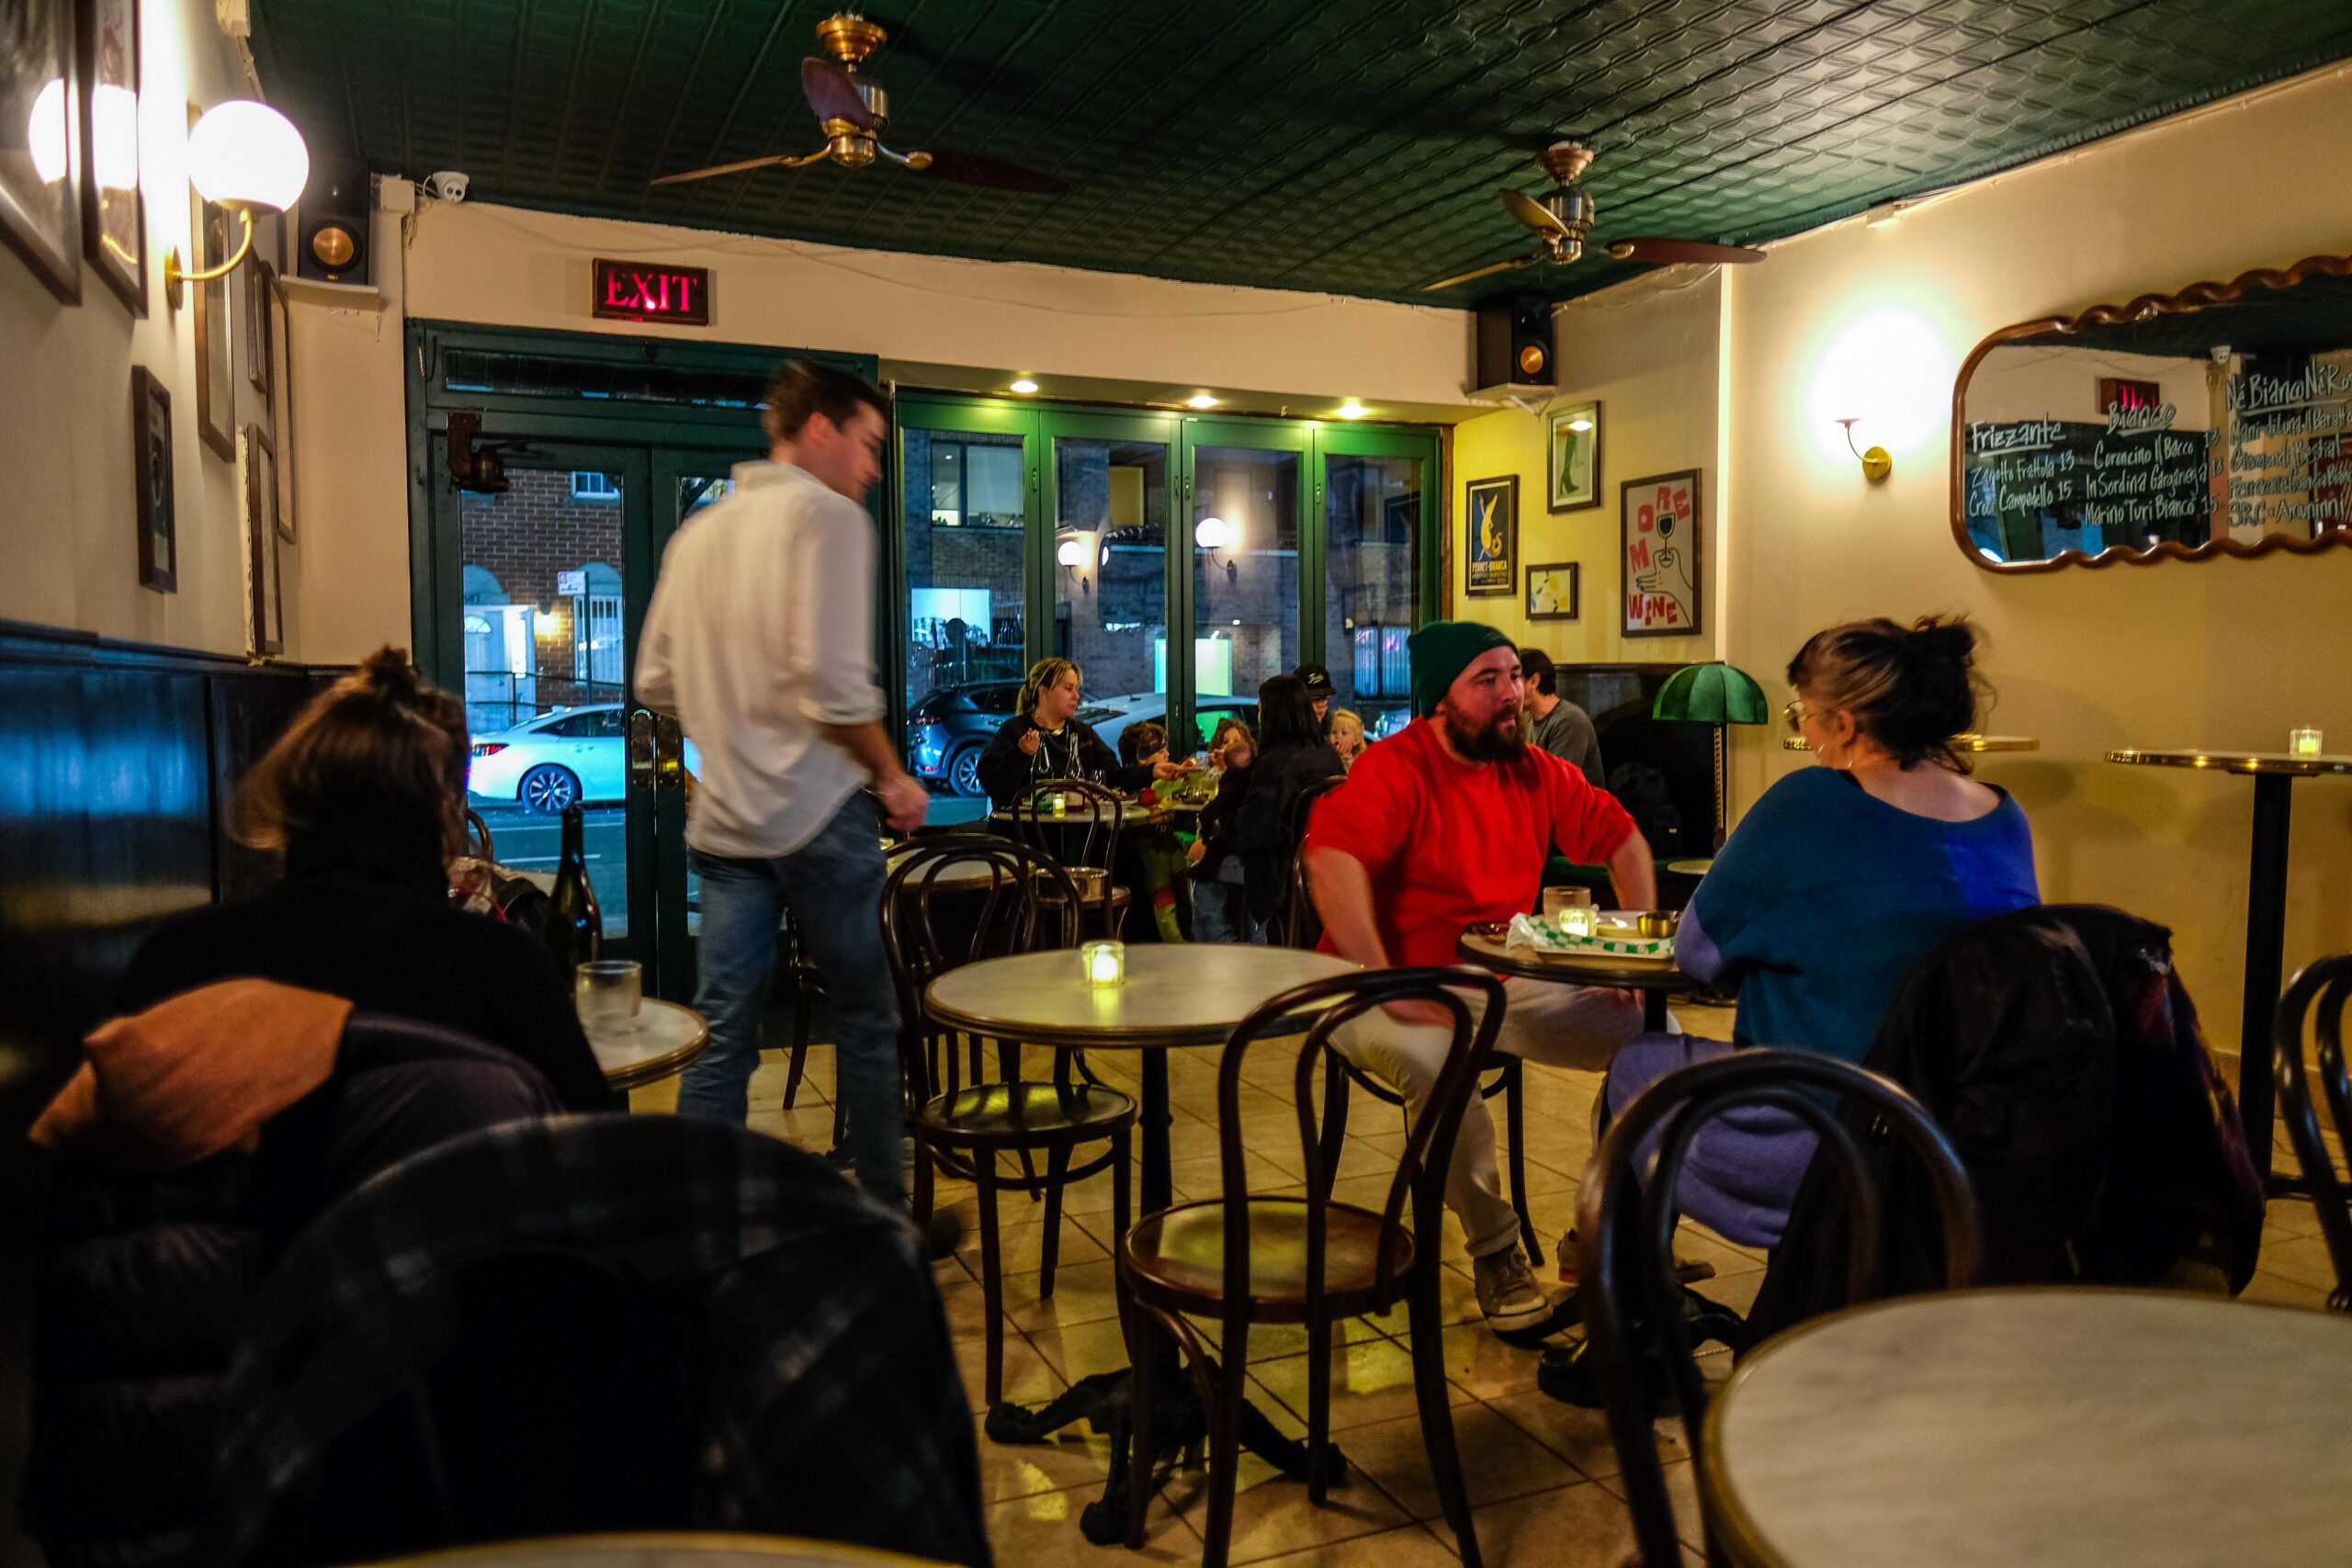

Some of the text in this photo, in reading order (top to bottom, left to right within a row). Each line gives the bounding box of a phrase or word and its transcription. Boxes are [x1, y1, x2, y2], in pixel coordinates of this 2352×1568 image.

[605, 270, 697, 311] EXIT
[1972, 412, 2066, 452] Frizzante
[2107, 401, 2177, 435] Bianco
[2060, 450, 2075, 472] 13
[2164, 436, 2194, 460] Bacco
[2058, 479, 2073, 502] 15
[1629, 593, 1678, 626] WINE
